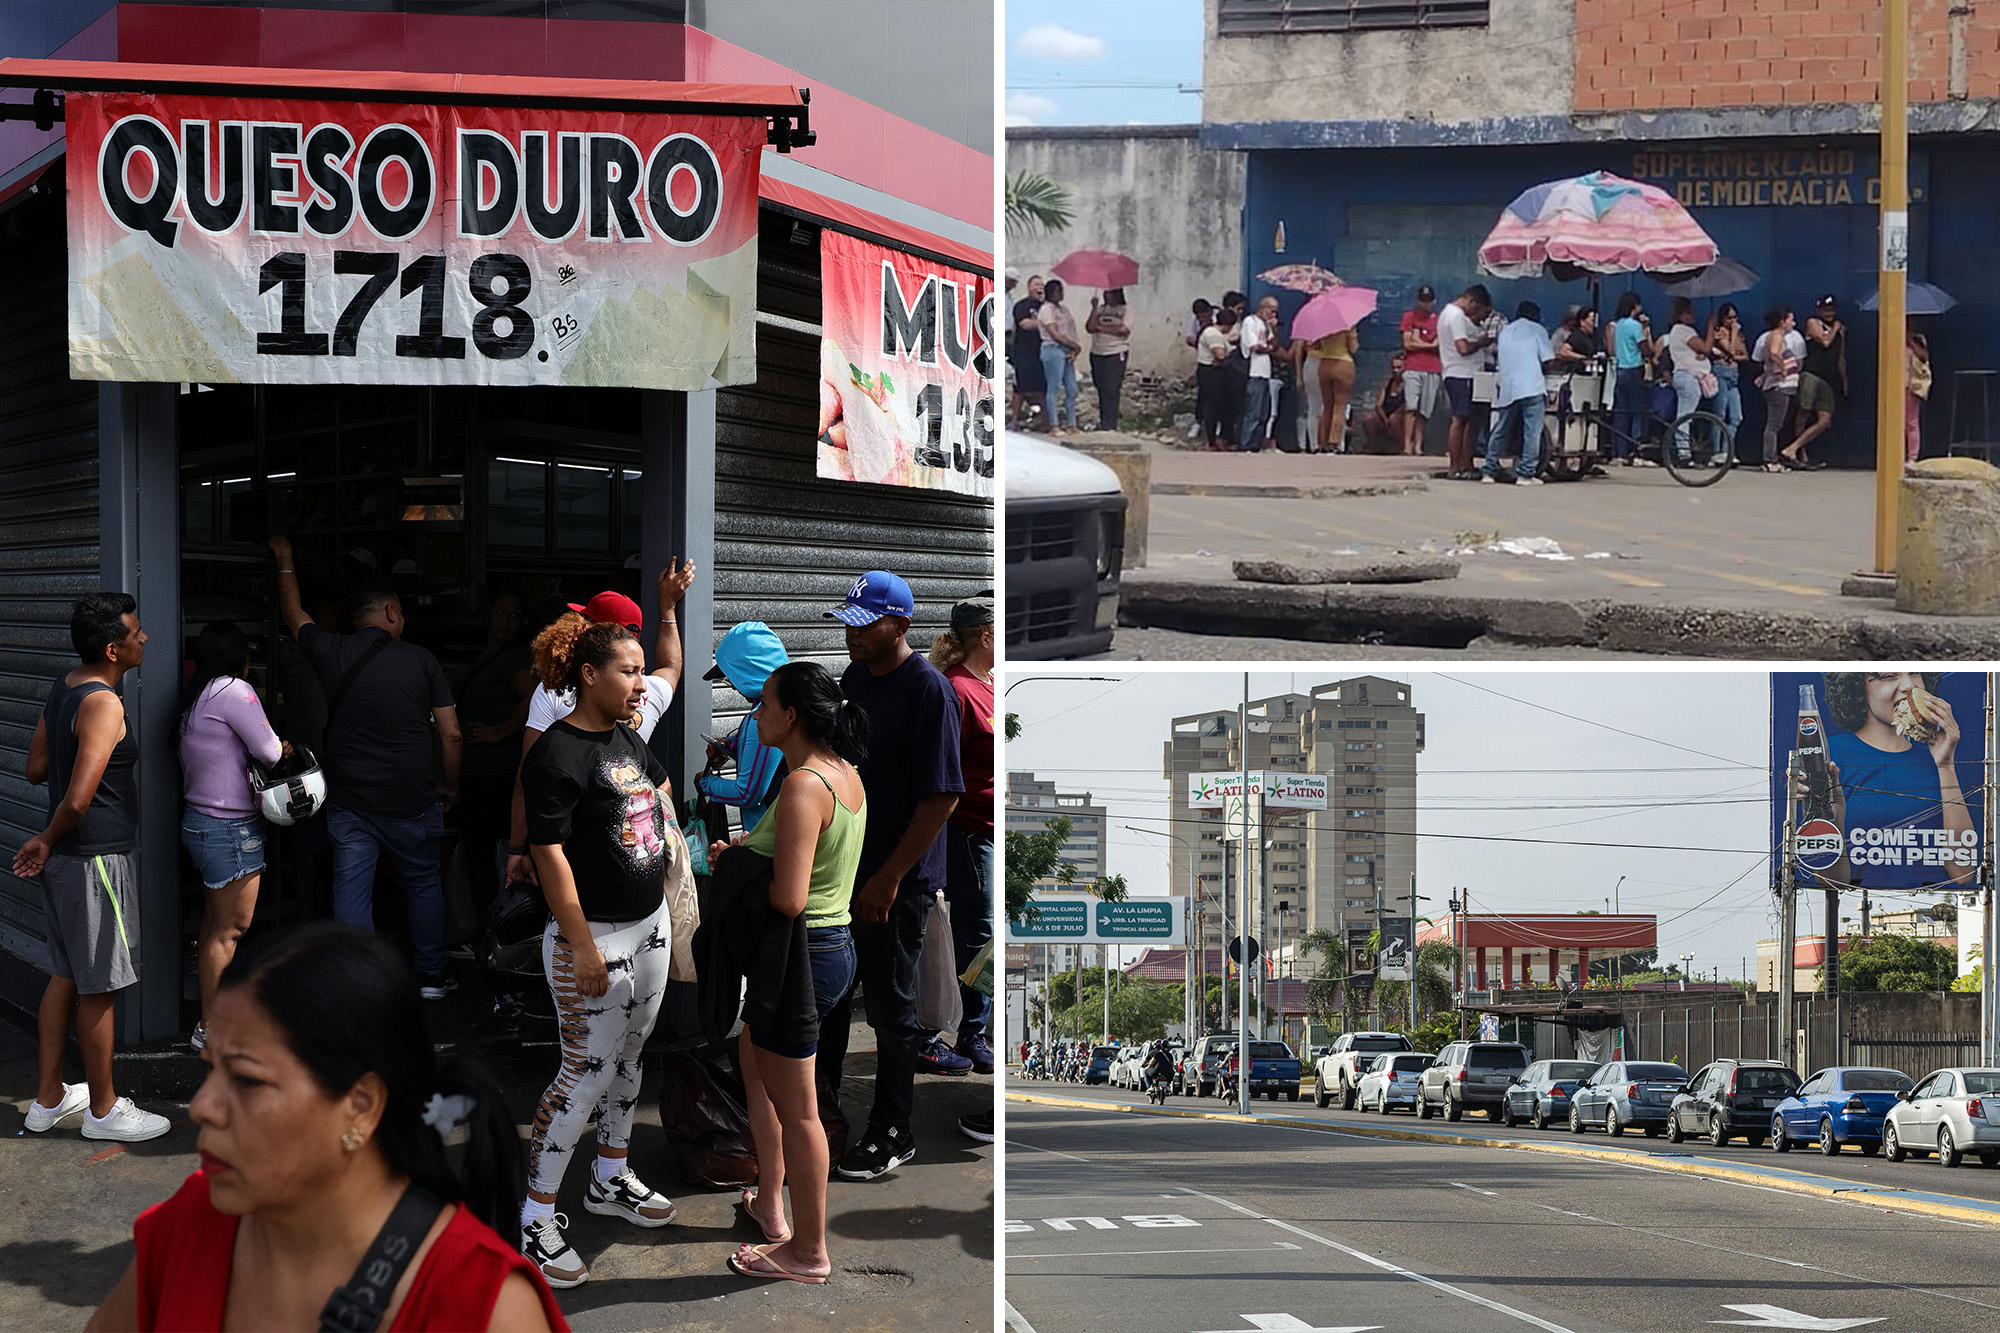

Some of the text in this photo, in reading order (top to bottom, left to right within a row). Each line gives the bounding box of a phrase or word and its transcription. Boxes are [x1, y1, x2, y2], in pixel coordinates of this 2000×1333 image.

[1632, 150, 1854, 178] SUPERMERCADO
[97, 114, 724, 249] QUESO DURO
[256, 250, 549, 362] 1718.
[1798, 746, 1823, 755] PEPSI
[1214, 776, 1261, 786] Super Tinda
[1287, 777, 1325, 788] Super Tienda
[1287, 787, 1325, 798] LATINO
[1850, 824, 1978, 848] COMÉTELO
[1796, 838, 1840, 850] PEPSI
[1850, 847, 1978, 866] CON PEPSI
